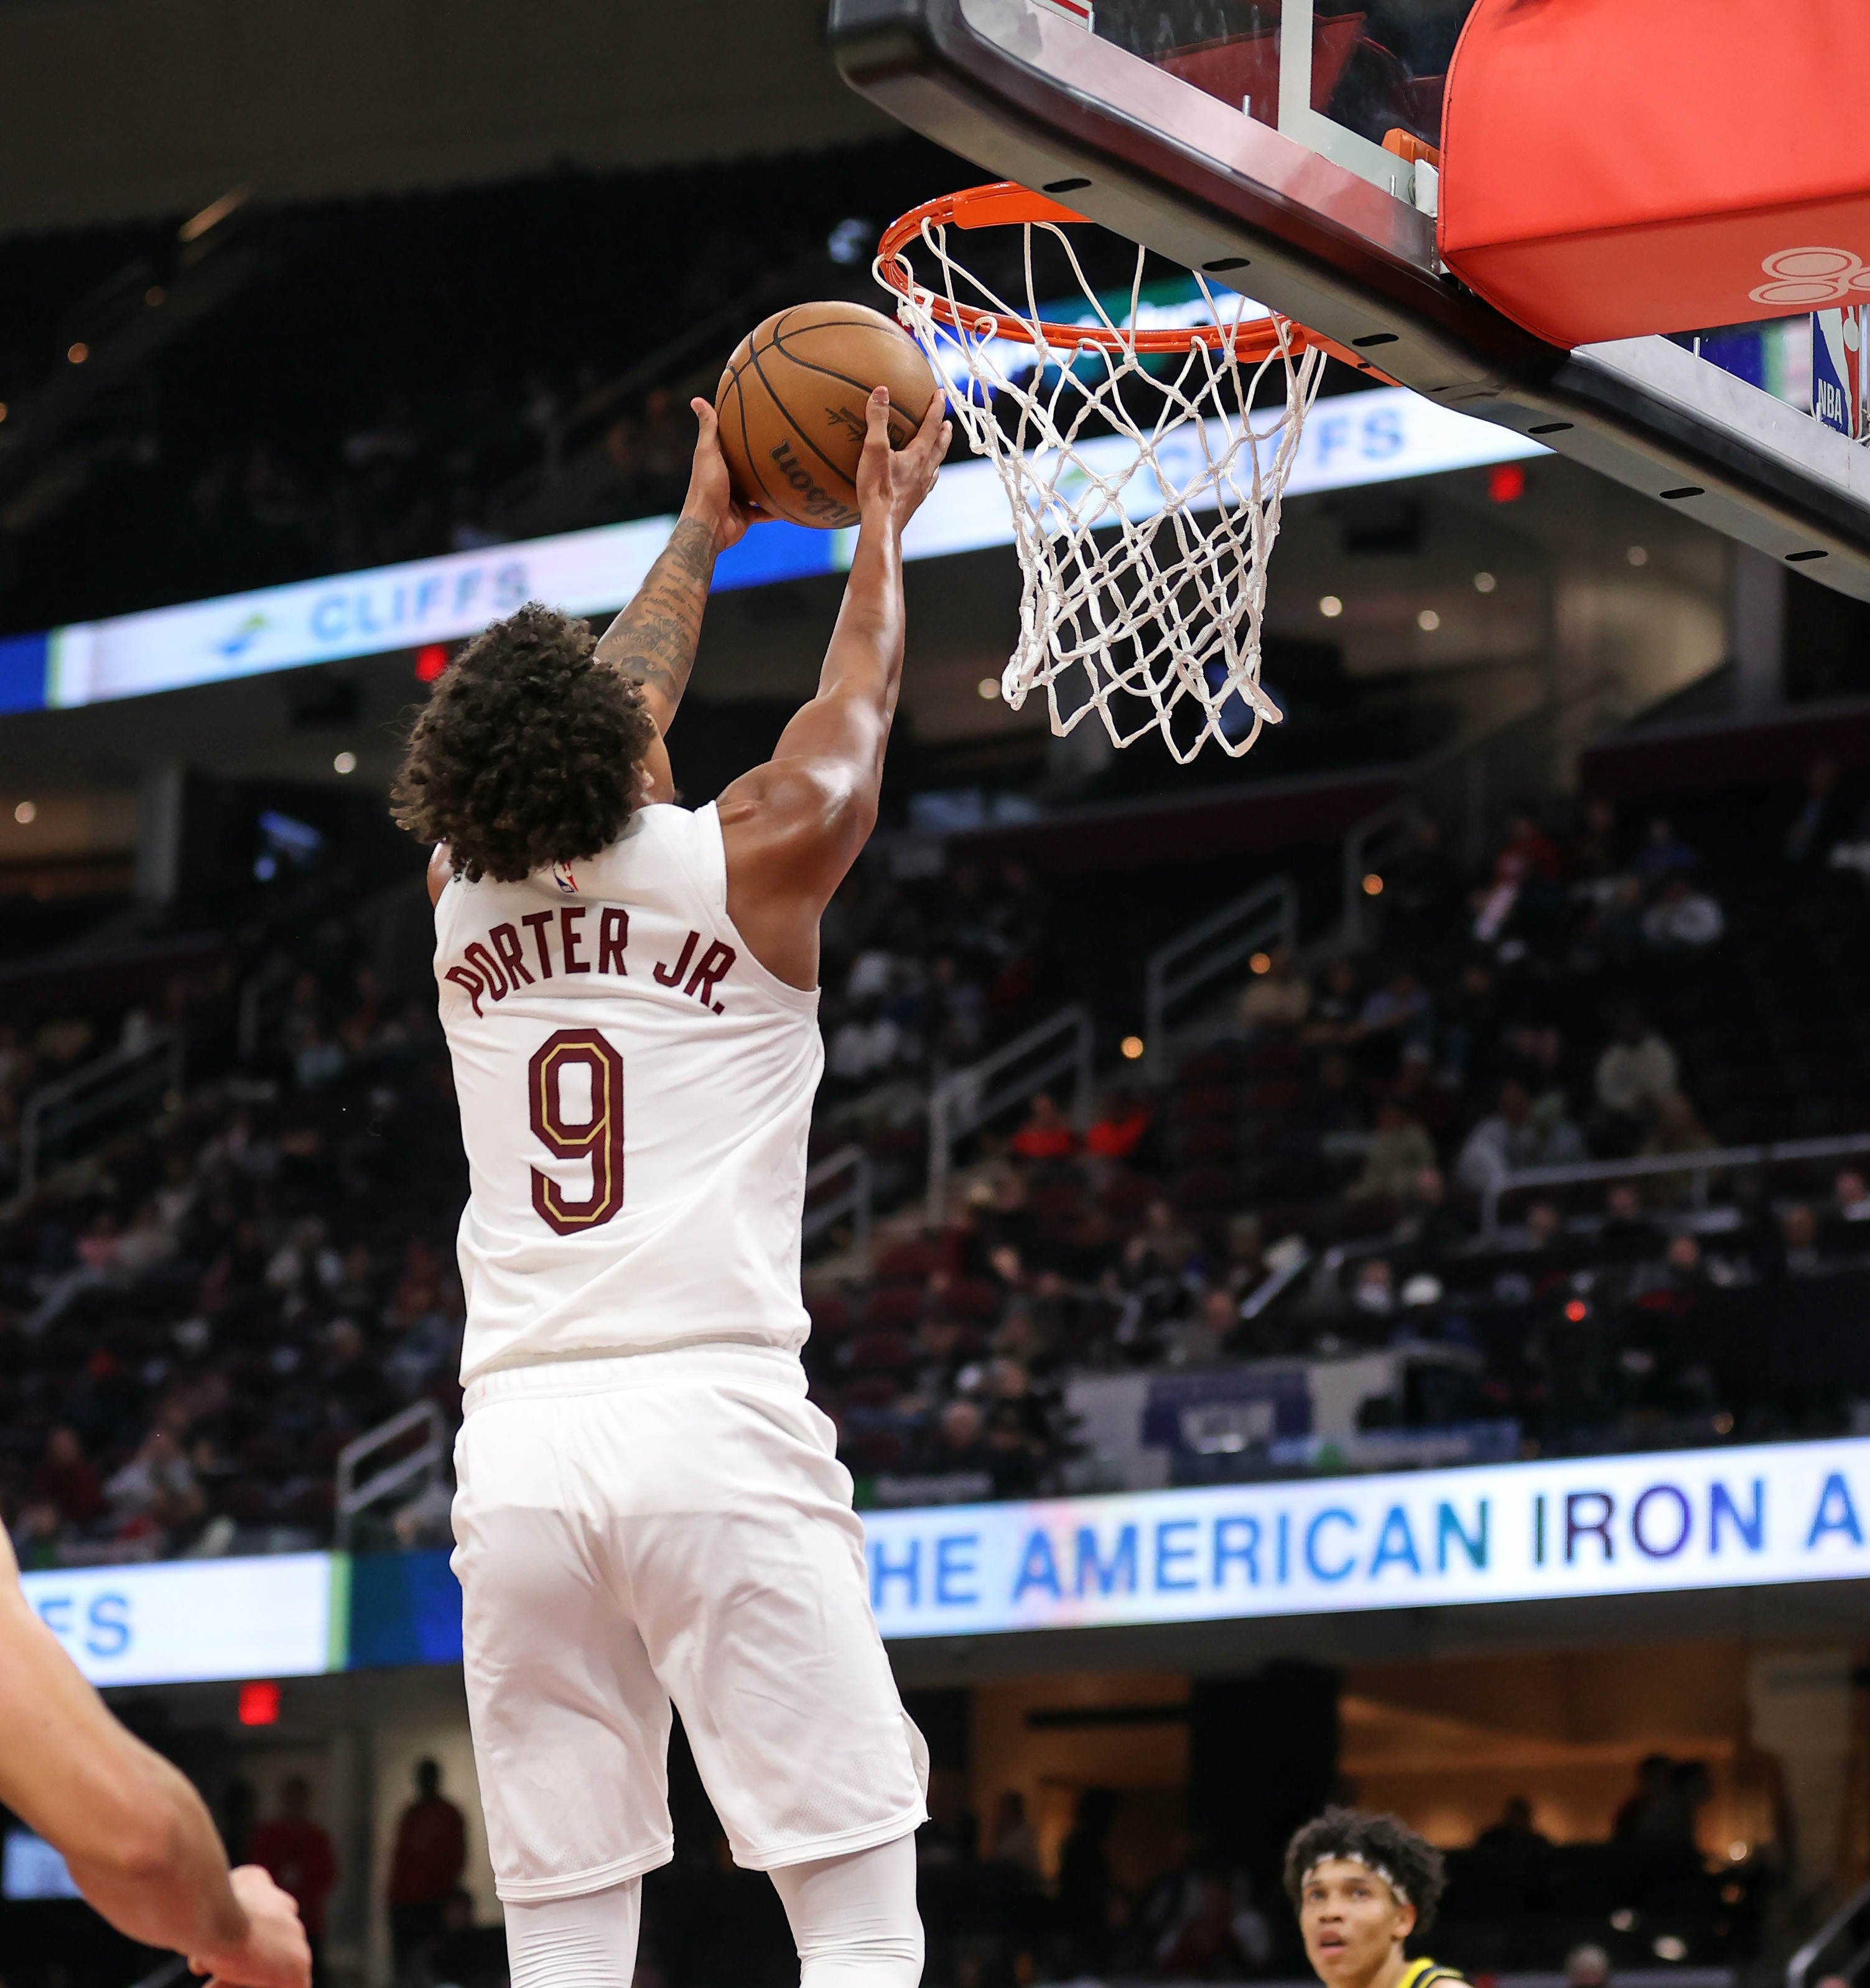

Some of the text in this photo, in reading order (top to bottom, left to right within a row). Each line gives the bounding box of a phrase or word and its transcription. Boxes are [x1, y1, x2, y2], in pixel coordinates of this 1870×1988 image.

[1818, 378, 1843, 424] NBA
[310, 562, 531, 641] CLIFFS
[445, 907, 737, 1019] PORTER JR.
[529, 1028, 624, 1236] 9
[1012, 1498, 1489, 1605] AMERICAN
[1533, 1477, 1765, 1567] IRON
